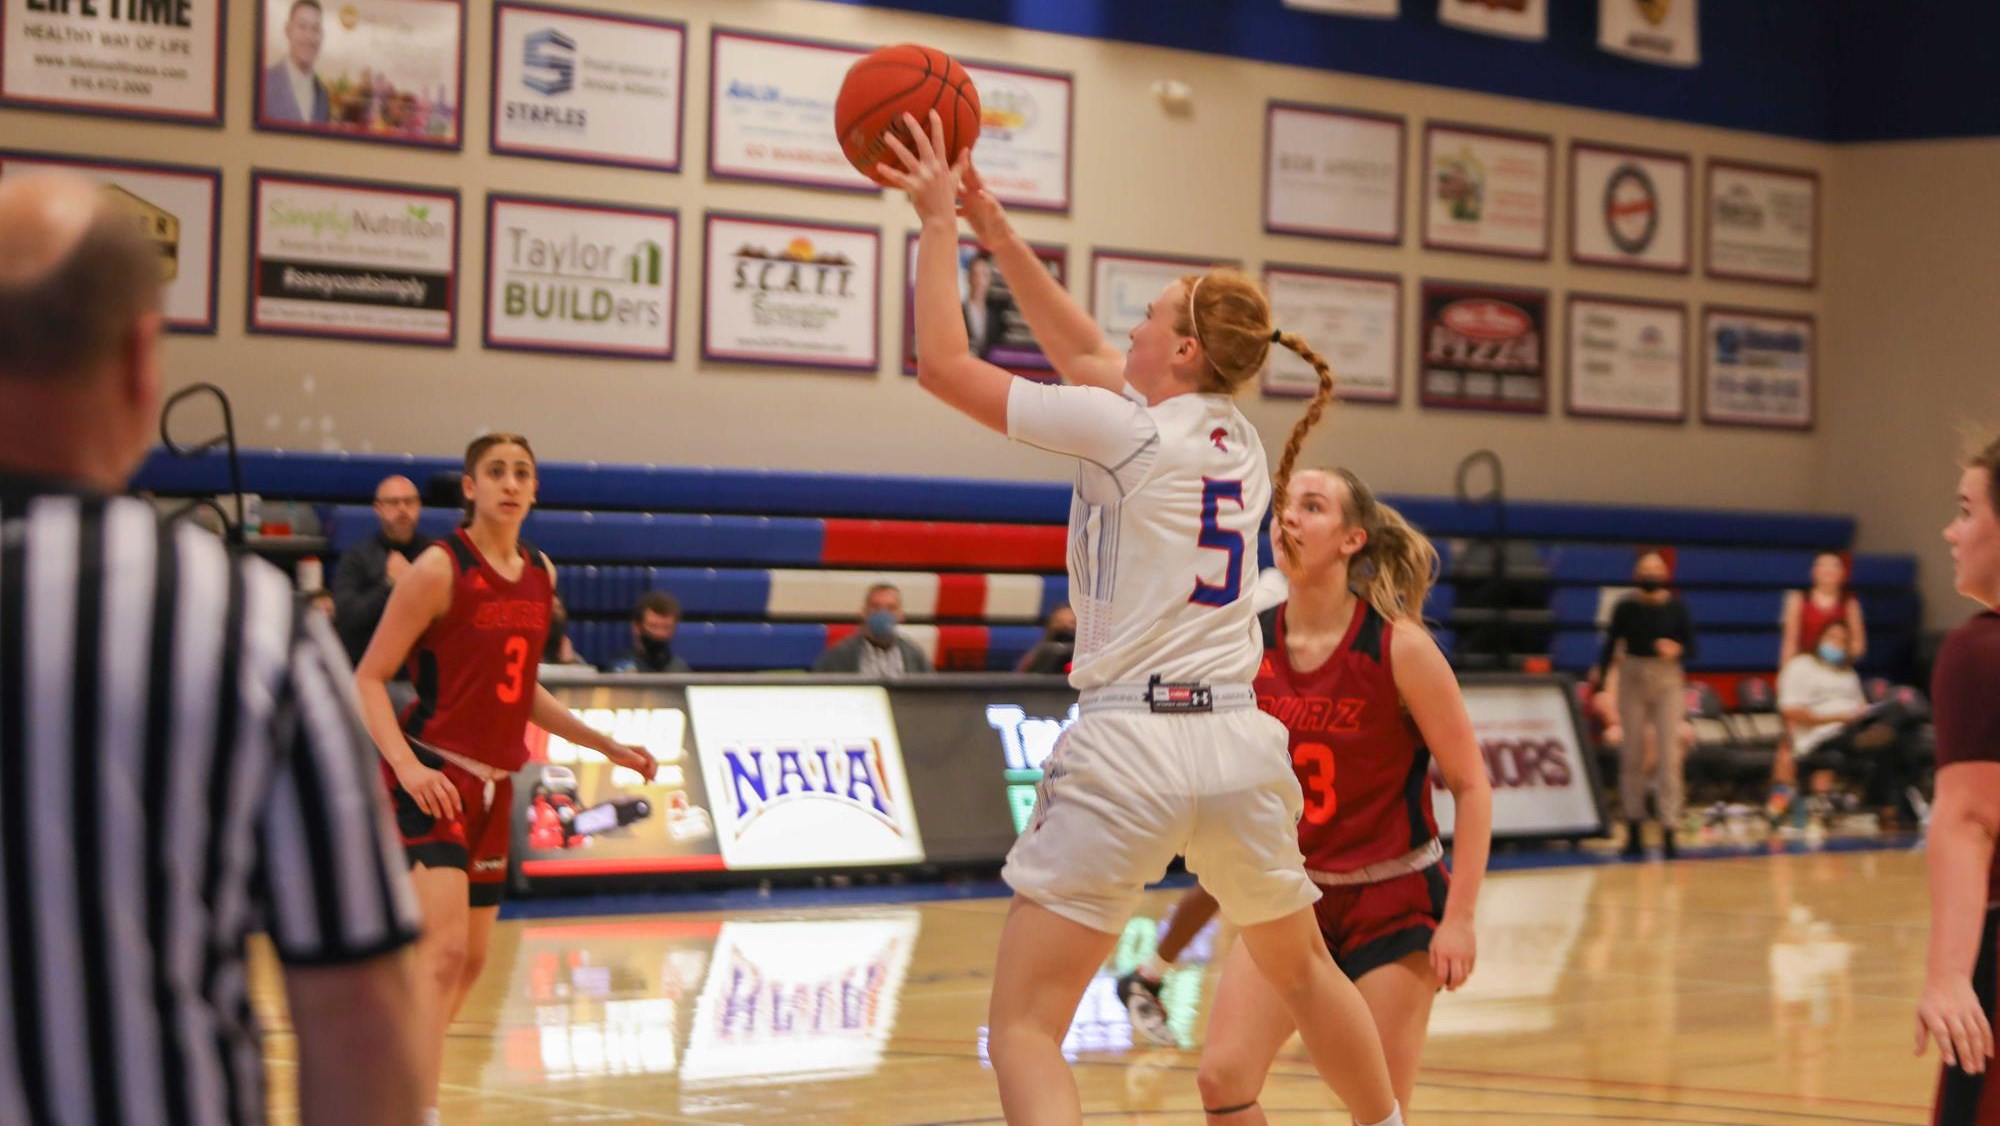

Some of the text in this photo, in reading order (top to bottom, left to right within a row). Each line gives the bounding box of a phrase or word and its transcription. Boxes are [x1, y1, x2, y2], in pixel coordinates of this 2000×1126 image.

[24, 24, 191, 55] HEALTHY WAY OF LIFE
[506, 101, 588, 130] STAPLES
[507, 226, 617, 276] Taylor
[504, 281, 661, 327] BUILDers
[1189, 476, 1244, 608] 5
[496, 636, 528, 704] 3
[1257, 696, 1366, 733] UAZ
[722, 745, 890, 820] NAIA
[1294, 742, 1338, 825] 3
